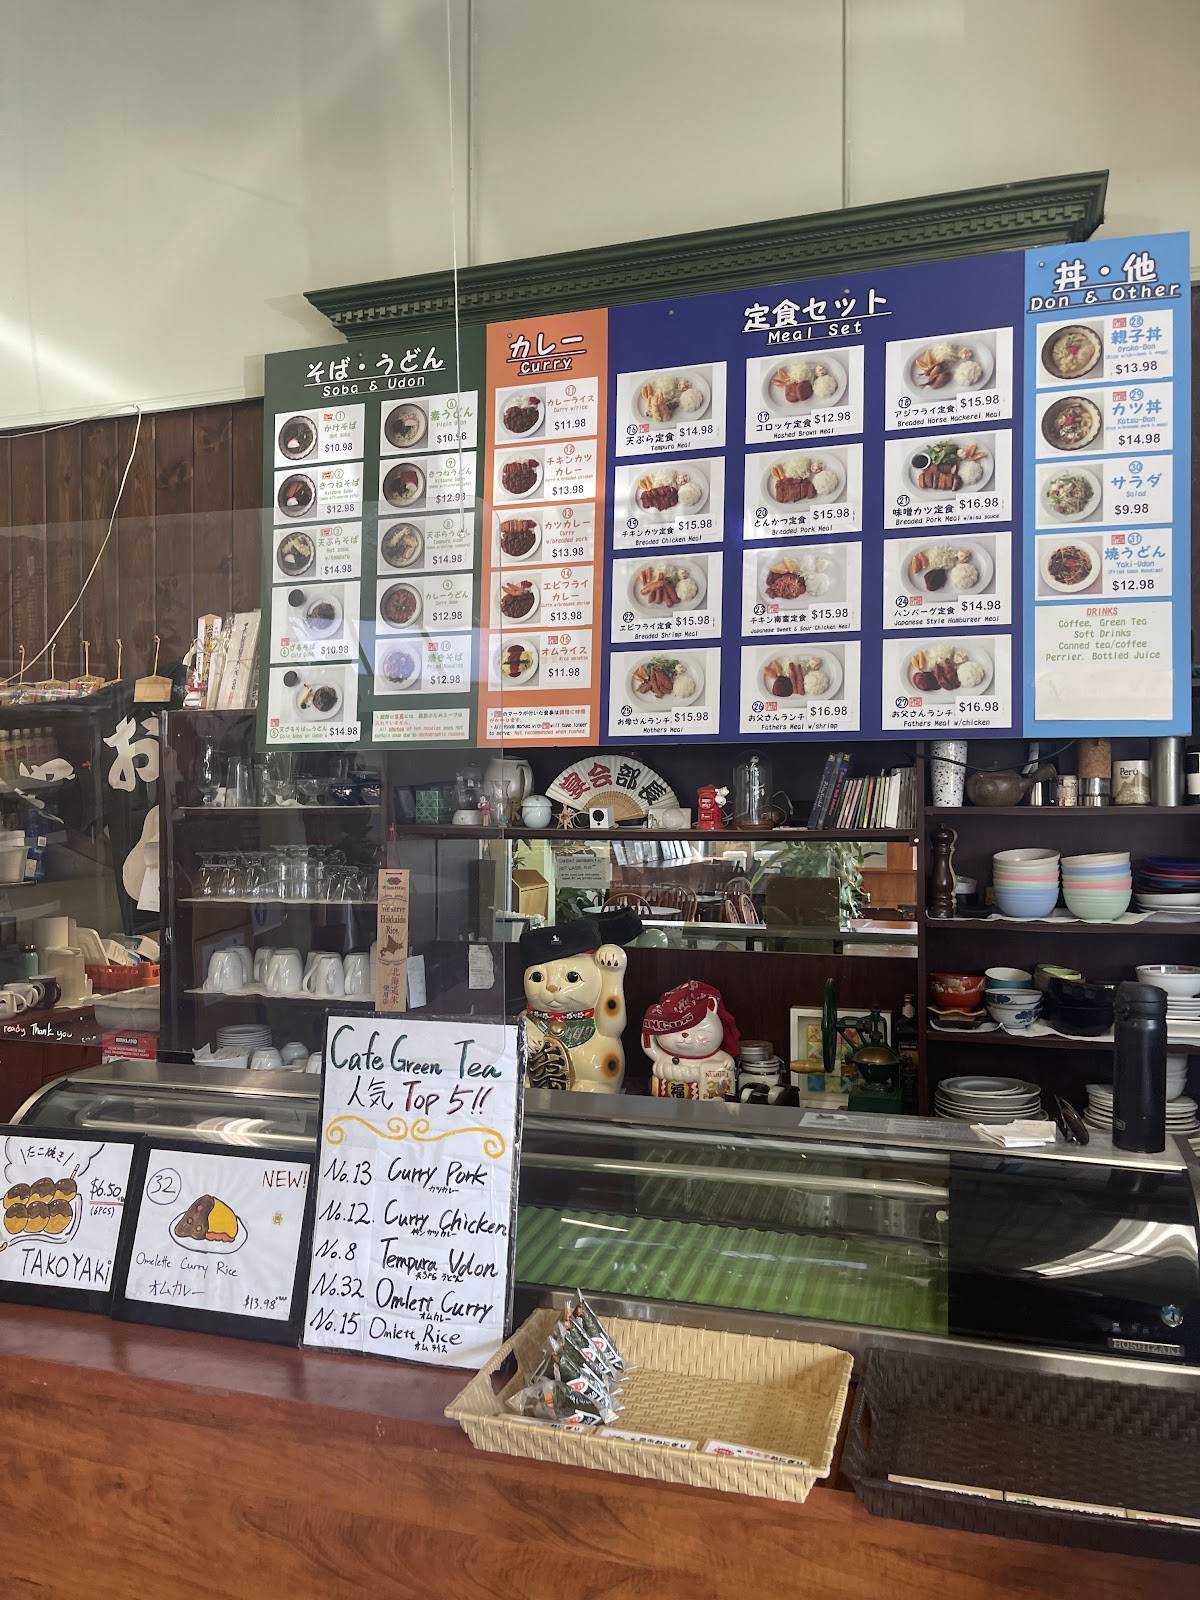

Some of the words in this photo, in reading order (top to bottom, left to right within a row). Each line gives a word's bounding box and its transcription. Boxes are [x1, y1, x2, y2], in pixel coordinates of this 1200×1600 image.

[1055, 251, 1157, 290] 丼・他
[1031, 295, 1069, 311] Don
[1085, 290, 1098, 304] &
[1112, 283, 1180, 301] Other
[743, 289, 887, 331] 定食セット
[767, 325, 813, 344] Meal
[828, 321, 863, 337] Set
[1111, 327, 1163, 345] 親子丼
[509, 332, 584, 358] カレー
[306, 346, 444, 383] そば・うどん
[1115, 361, 1158, 375] $13.98
[322, 384, 359, 397] Soba
[368, 380, 379, 391] &
[387, 375, 426, 389] Udon
[547, 395, 595, 407] カレーライス
[960, 394, 1000, 408] $15.98
[894, 404, 956, 418] アジフライ定食
[1112, 399, 1163, 416] カツ丼
[814, 411, 851, 425] $12.98
[897, 418, 925, 427] Breaded
[927, 416, 947, 425] Horse
[950, 413, 982, 423] Mackerel
[985, 410, 1001, 419] Meal
[554, 418, 587, 431] $11.98
[679, 424, 714, 437] $14.98
[755, 418, 812, 432] コロッケ定食
[625, 432, 675, 447] 天ぷら定食
[798, 429, 820, 438] Brown
[1118, 433, 1161, 446] $14.98
[324, 442, 353, 453] $10.98
[546, 454, 592, 465] チキンカツ
[555, 467, 583, 476] カレー
[1111, 473, 1163, 489] サラダ
[552, 484, 584, 496] $13.98
[1126, 490, 1147, 498] Salad
[326, 504, 355, 514] $12.98
[959, 498, 999, 510] $16.98
[1114, 503, 1149, 515] $9.98
[813, 508, 850, 520] $15.98
[892, 504, 955, 517] 味噌カツ定食
[544, 519, 592, 531] カツカレー
[678, 519, 713, 531] $15.98
[754, 515, 807, 528] とんかつ定食
[895, 517, 923, 526] Breaded
[926, 516, 942, 524] Pork
[945, 514, 960, 522] Meal
[621, 526, 675, 537] チキンカツ定食
[771, 527, 799, 536] Breaded
[800, 525, 817, 534] Pork
[818, 524, 833, 532] Meal
[635, 538, 660, 546] Breaded
[661, 536, 686, 545] Chicken
[688, 534, 702, 542] Meal
[551, 547, 584, 558] $13.98
[1104, 546, 1166, 560] 焼うどん
[432, 554, 462, 565] $14.98
[324, 565, 352, 575] $14.98
[543, 579, 589, 590] エビフライ
[1112, 579, 1154, 591] $12.98
[552, 593, 580, 602] カレー
[961, 600, 1001, 611] $14.98
[1086, 607, 1118, 616] DRINKS
[432, 612, 463, 622] $12.98
[550, 611, 582, 622] $13.98
[811, 608, 849, 620] $15.98
[894, 607, 956, 617] ハンバーグ定食
[675, 615, 710, 628] $15.98
[894, 618, 923, 626] Japanese
[926, 617, 945, 625] Style
[948, 616, 982, 624] Hamburger
[985, 615, 1000, 623] Meal
[1099, 618, 1126, 627] Green
[1132, 618, 1147, 626] Tea
[619, 622, 672, 632] エビフライ定食
[635, 632, 660, 640] Breaded
[661, 631, 683, 639] Shrimp
[684, 630, 698, 638] Meal
[1074, 629, 1095, 639] Soft
[1099, 629, 1132, 638] Drinks
[321, 645, 349, 655] $10.98
[1058, 641, 1090, 650] Canned
[1095, 639, 1147, 649] tea/coffee
[541, 646, 588, 656] オムライス
[1092, 651, 1129, 660] Bottled
[1134, 650, 1161, 659] Juice
[548, 667, 580, 678] $11.98
[430, 675, 461, 685] $12.98
[810, 706, 848, 717] $16.98
[959, 702, 999, 712] $16.98
[674, 712, 709, 723] $15.98
[748, 713, 805, 722] お父さんランチ
[891, 709, 953, 718] お父さんランチ
[617, 716, 670, 726] お母さんランチ
[761, 723, 788, 731] Fathers
[790, 722, 805, 730] Meal
[807, 722, 838, 731] w/shrimp
[903, 719, 931, 728] Fathers
[934, 719, 950, 727] Meal
[954, 718, 991, 726] w/chicken
[329, 727, 358, 737] $14.98
[643, 726, 668, 734] Mothers
[670, 725, 684, 733] Meal
[3, 1023, 26, 1037] ready
[30, 1022, 54, 1037] Thank
[56, 1029, 73, 1041] you
[330, 1024, 385, 1071] Cafe
[390, 1034, 443, 1075] Green
[454, 1039, 502, 1079] Tea
[346, 1075, 394, 1111] 人気
[403, 1080, 440, 1116] Top
[446, 1083, 495, 1115] 5!!
[670, 1081, 686, 1099] 福
[387, 1156, 438, 1189] Curry
[446, 1160, 488, 1186] Pork
[153, 1173, 177, 1195] 32
[262, 1170, 308, 1189] NEW!
[90, 1177, 121, 1199] $6.50
[383, 1199, 430, 1231] Curry
[438, 1208, 508, 1237] Chicken
[315, 1239, 357, 1261] No.8
[380, 1237, 438, 1275] Tempura
[448, 1248, 499, 1278] Udon
[136, 1252, 172, 1269] Omelette
[180, 1255, 209, 1277] Curry
[216, 1261, 239, 1277] Rice
[148, 1279, 205, 1296] オムカレー
[243, 1294, 276, 1311] $13.98
[311, 1272, 365, 1298] No.32
[376, 1277, 434, 1313] Omlett
[440, 1290, 494, 1324] Curry
[309, 1307, 361, 1335] No.15
[369, 1316, 416, 1340] Omlett
[422, 1323, 463, 1346] Rice
